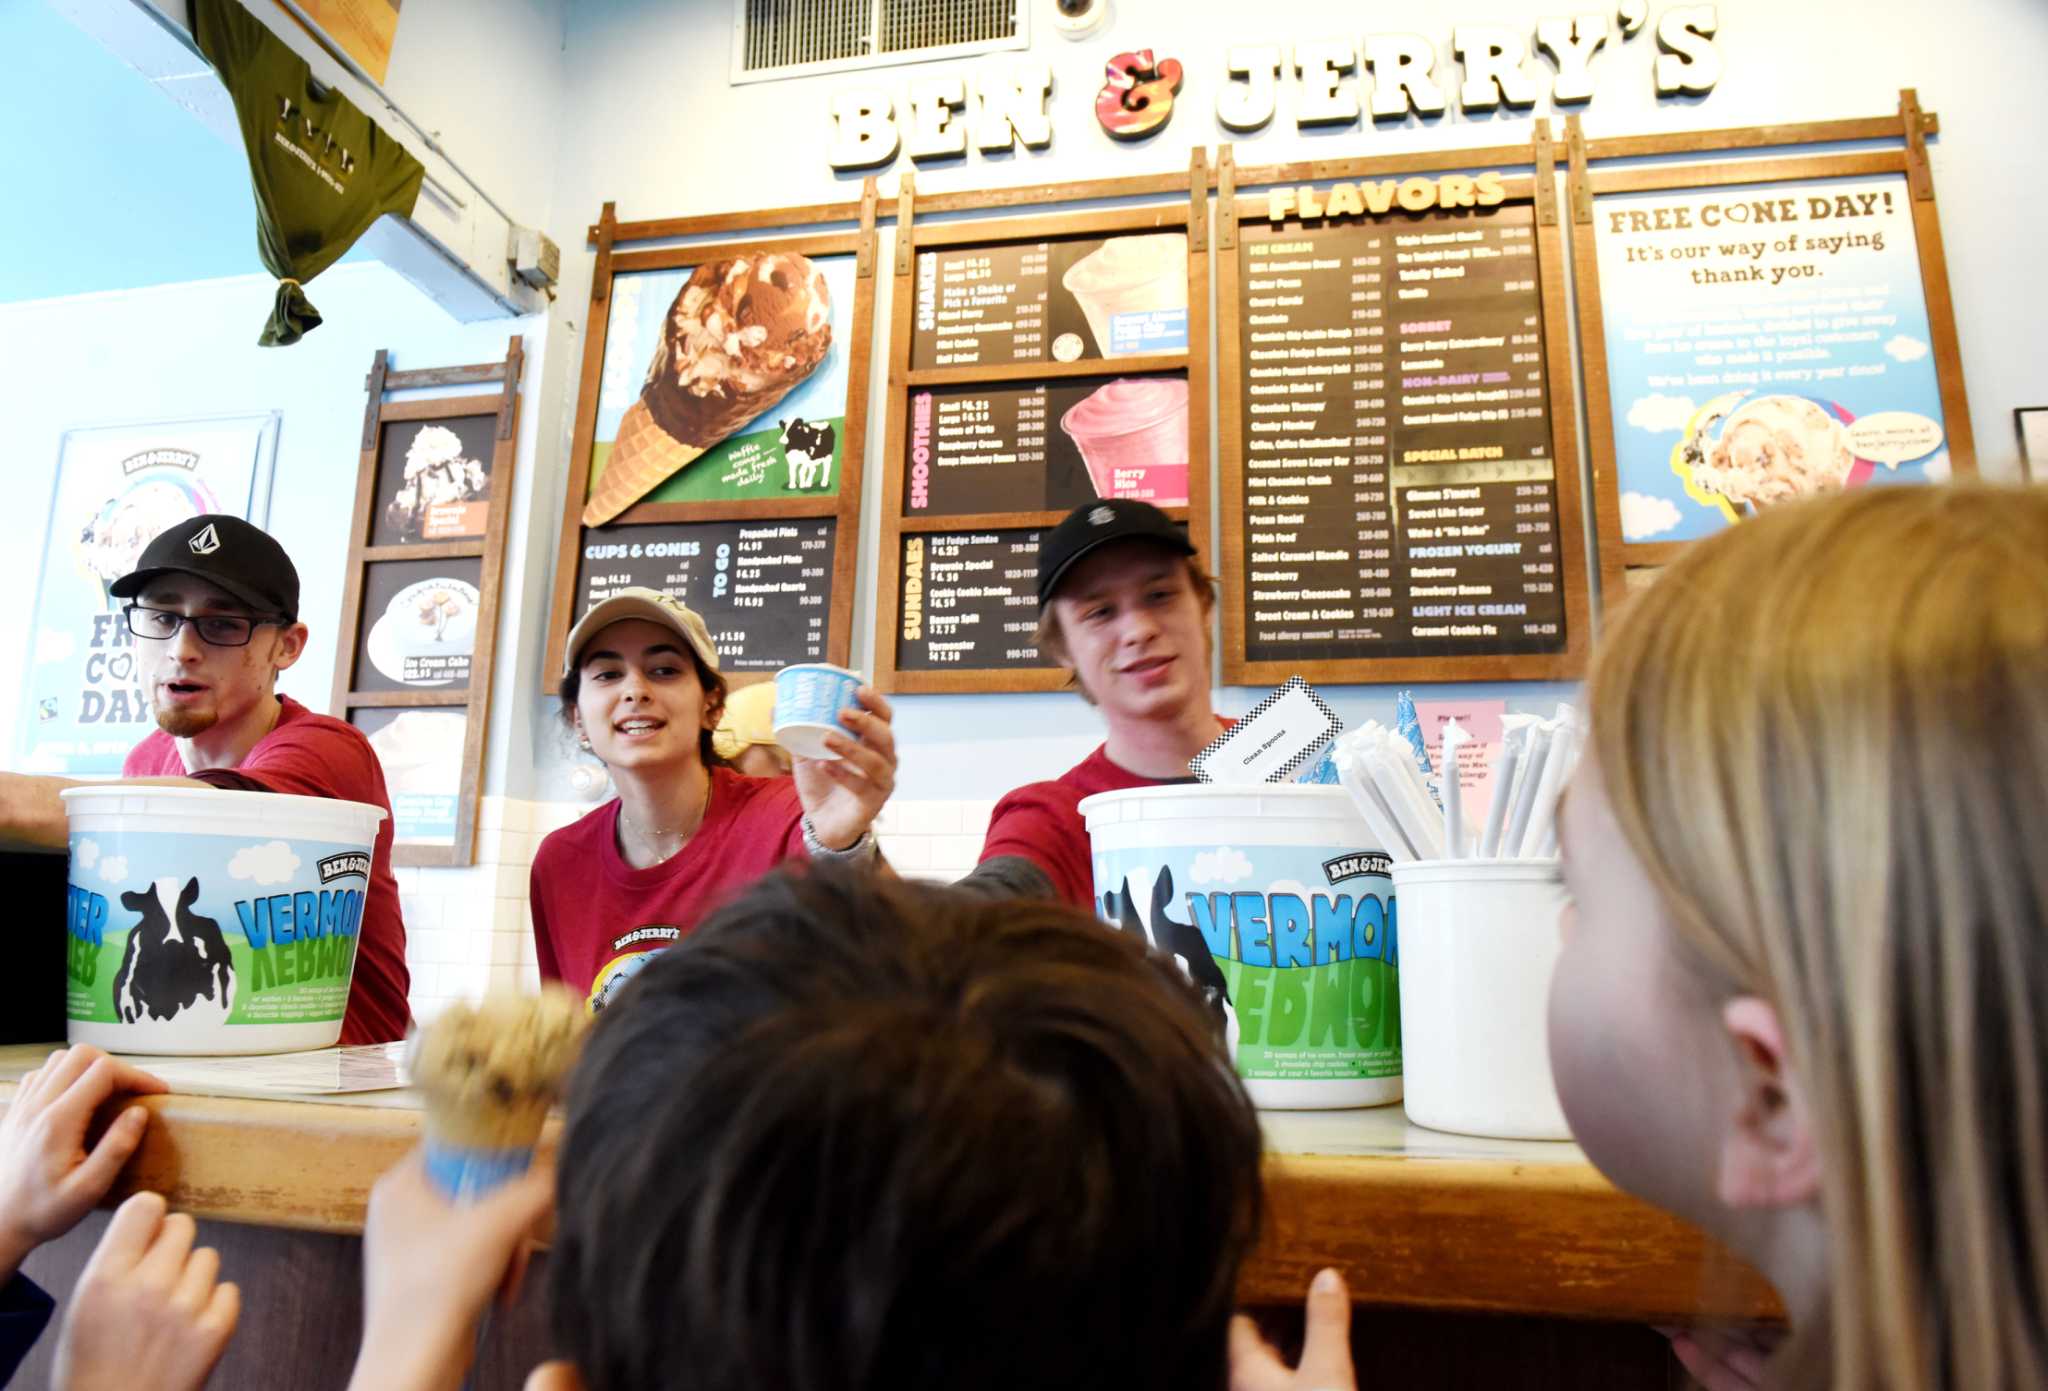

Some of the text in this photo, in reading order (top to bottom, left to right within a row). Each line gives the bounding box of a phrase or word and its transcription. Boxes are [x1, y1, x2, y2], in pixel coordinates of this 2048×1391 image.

[829, 0, 1720, 172] BEN & JERRY'S
[1269, 172, 1505, 221] FLAVORS
[1609, 206, 1693, 233] FREE
[1807, 192, 1894, 220] DAY!
[1627, 232, 1885, 262] It's our way of saying
[1691, 263, 1823, 285] thank you.
[919, 253, 937, 330] SHAKES
[977, 284, 1004, 295] Shake
[943, 298, 961, 308] Pick
[1400, 321, 1451, 334] SORBET
[1403, 374, 1479, 388] NON-DAIRY
[1404, 449, 1457, 462] SPECIAL
[1114, 468, 1145, 480] Berry
[948, 537, 969, 546] Fudge
[971, 536, 998, 545] Sundae
[585, 541, 700, 560] CUPS & CONES
[932, 546, 959, 557] $6.25
[1280, 551, 1314, 561] Caramel
[1409, 543, 1521, 558] FROZEN YOGURT
[965, 561, 993, 571] Special
[1252, 571, 1299, 581] Strawberry
[904, 537, 923, 640] SUNDAES
[983, 587, 1012, 597] Sundae
[1253, 589, 1351, 600] Strawberry Cheesecake
[1255, 609, 1354, 621] Sweet Cream & Cookies
[1413, 604, 1526, 617] LIGHT ICE CREAM
[930, 614, 979, 625] Banana Split
[1412, 626, 1449, 636] Caramel
[1450, 625, 1481, 636] Cookie
[929, 642, 975, 652] Vermonster
[420, 657, 446, 667] Cream
[448, 656, 469, 667] Cake
[1243, 729, 1287, 767] Clean Spoons
